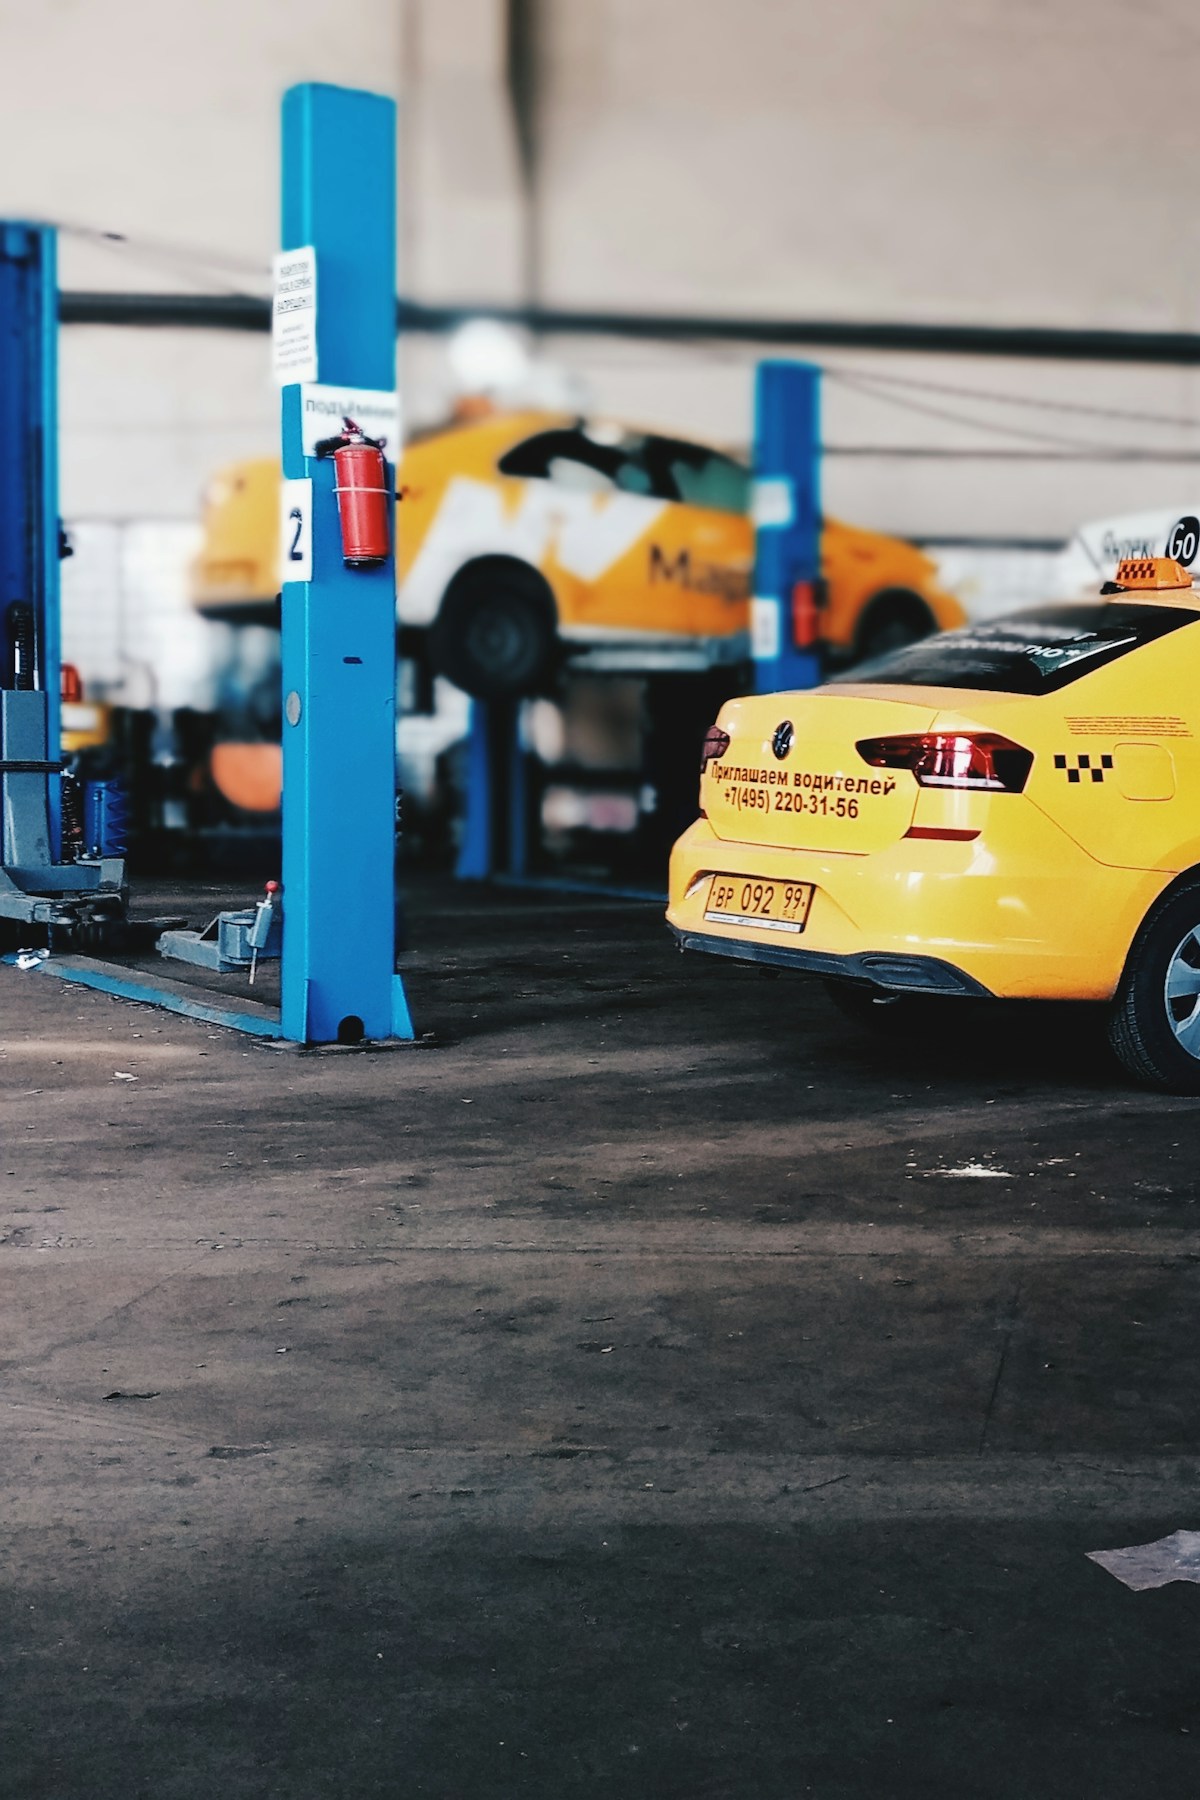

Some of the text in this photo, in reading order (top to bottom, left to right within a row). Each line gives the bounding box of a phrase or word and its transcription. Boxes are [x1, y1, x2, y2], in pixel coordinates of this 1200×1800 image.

[289, 508, 303, 561] 2
[1168, 522, 1196, 560] Go
[712, 761, 897, 796] Приглашаем водителей
[724, 786, 859, 819] +7(495) 220-31-56
[715, 883, 803, 914] ВР 092 99
